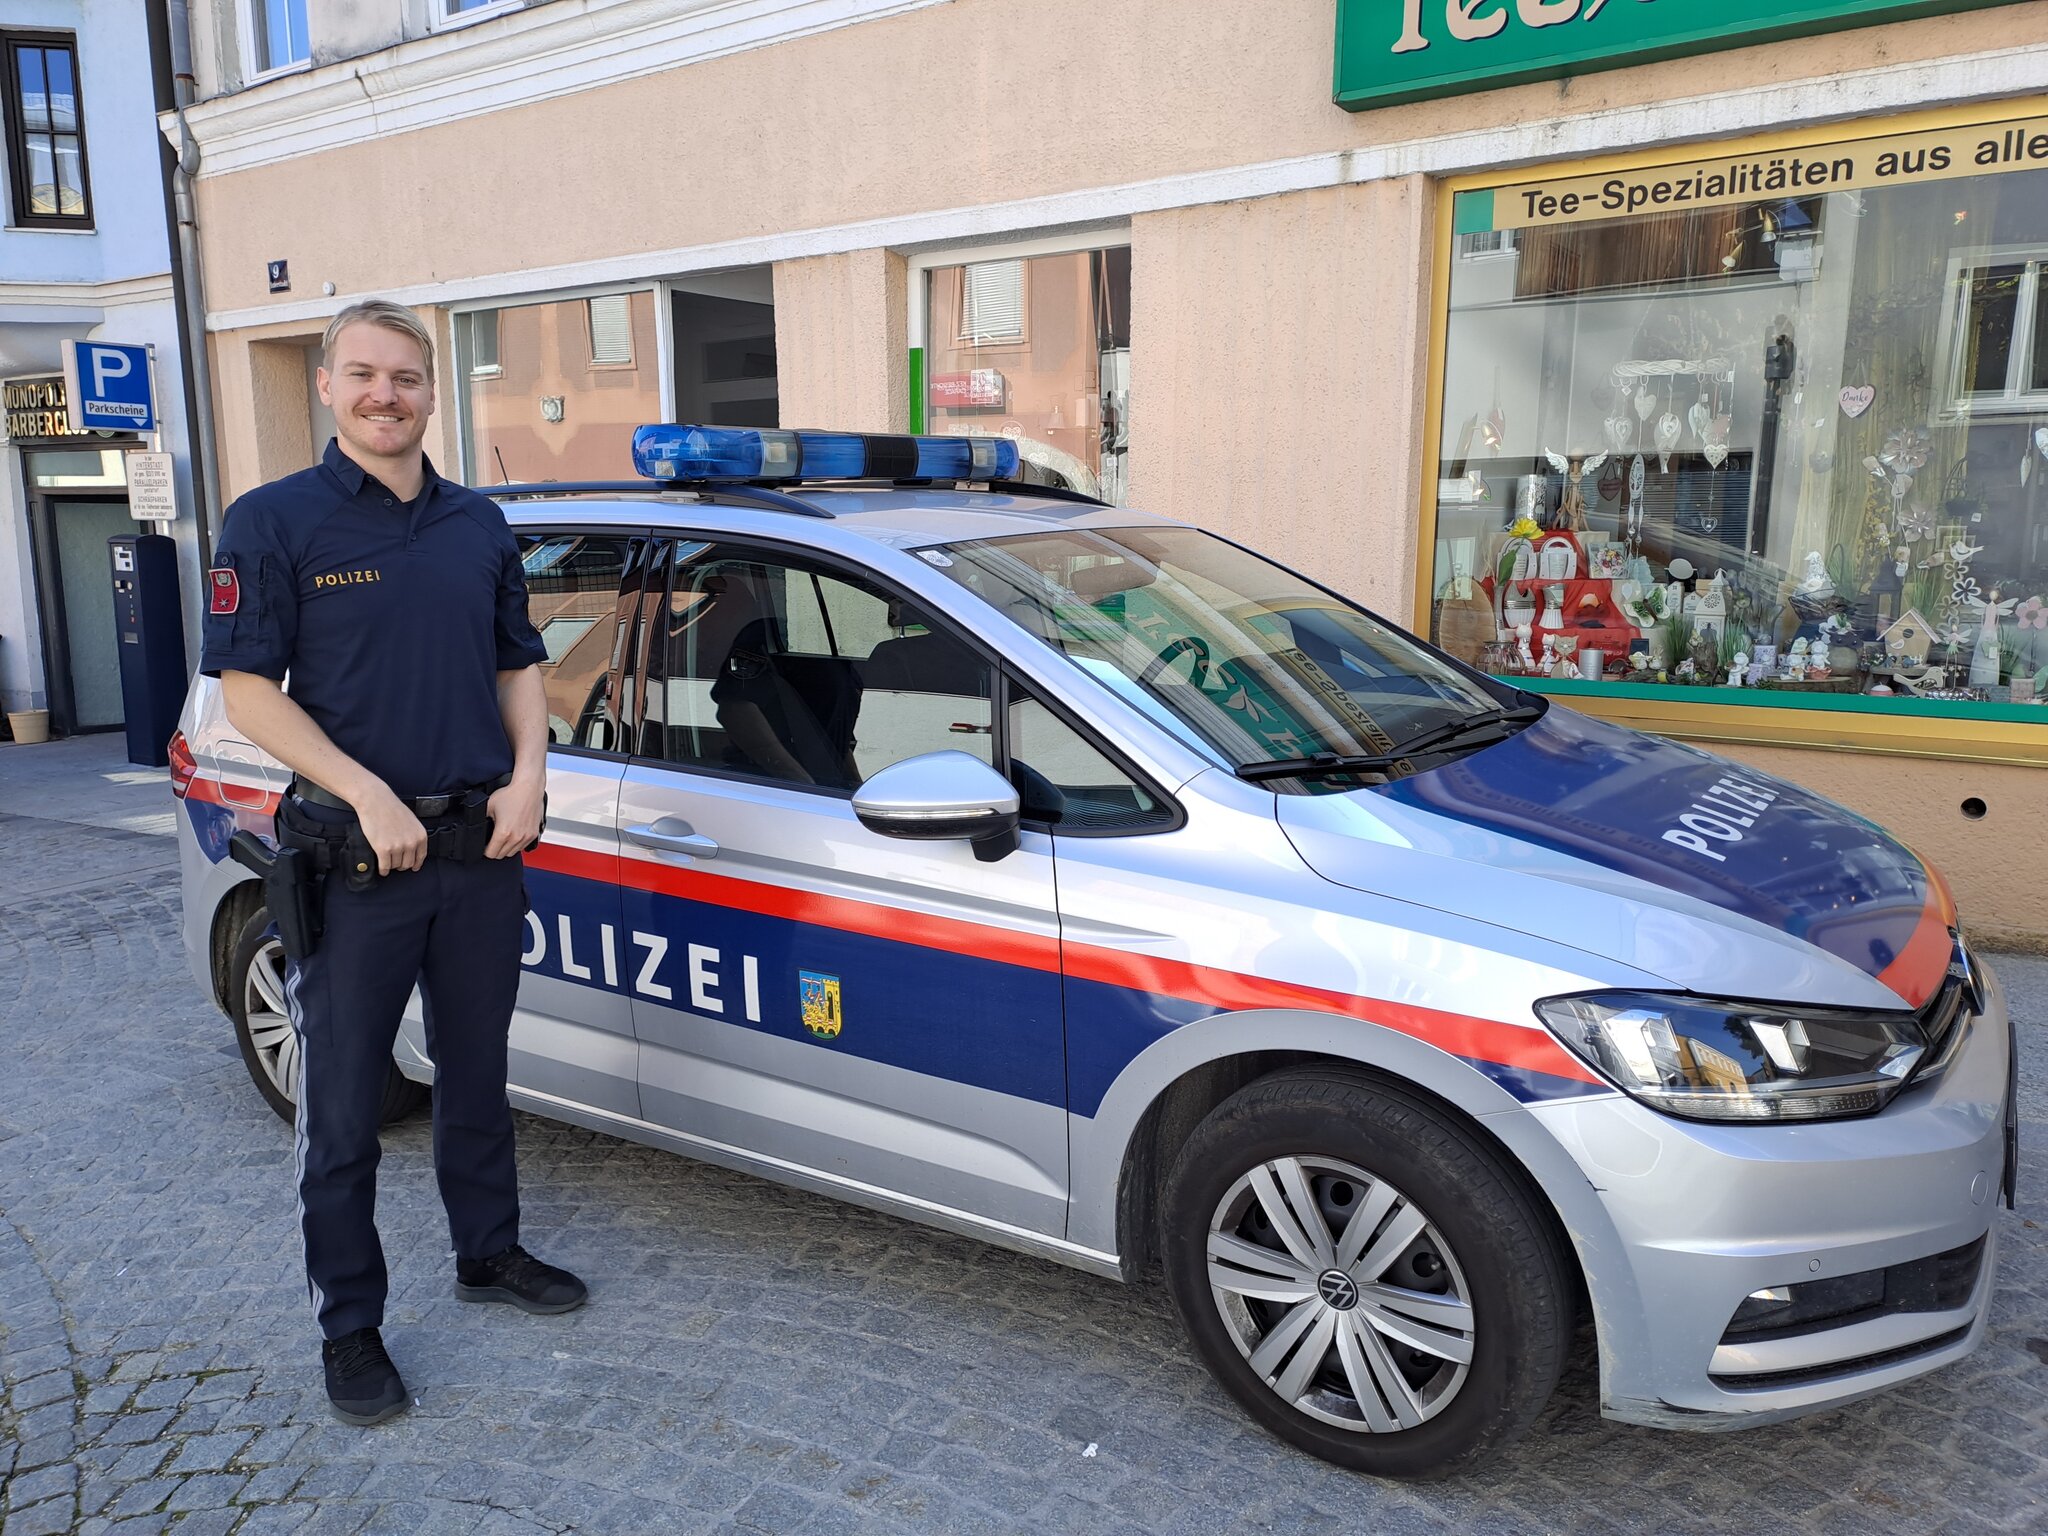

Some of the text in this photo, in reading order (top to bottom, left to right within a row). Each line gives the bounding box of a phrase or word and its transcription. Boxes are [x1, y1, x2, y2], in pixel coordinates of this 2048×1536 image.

[1522, 157, 1854, 218] Tee-Spezialitäten
[1875, 146, 1951, 177] aus
[272, 264, 279, 279] 9
[91, 347, 132, 398] P
[5, 411, 89, 437] BARBERCL
[88, 402, 145, 416] Parkscheine
[315, 569, 381, 589] POLIZEI
[1661, 774, 1780, 862] POLIZEI
[521, 909, 761, 1022] OLIZEI
